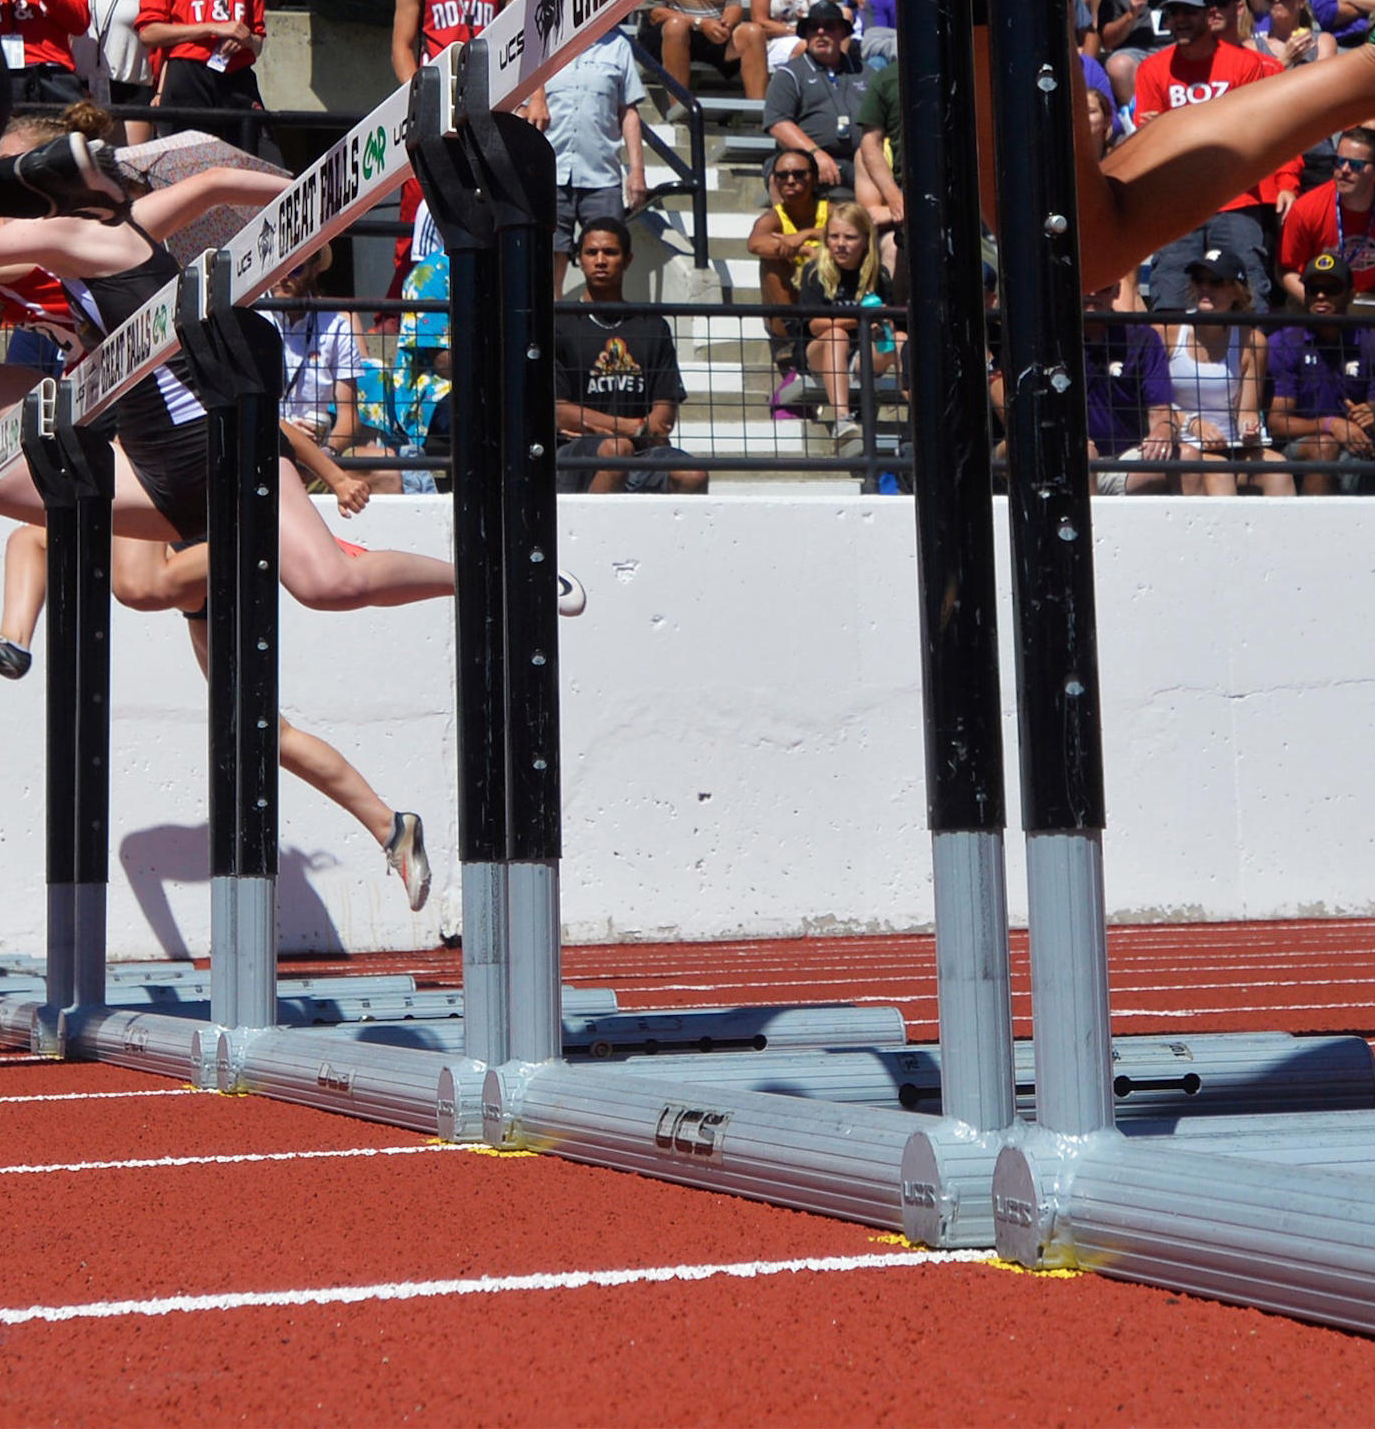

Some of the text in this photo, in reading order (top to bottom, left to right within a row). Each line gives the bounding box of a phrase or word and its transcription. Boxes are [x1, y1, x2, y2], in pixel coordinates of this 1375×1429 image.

[191, 0, 202, 22] T
[499, 29, 524, 71] UCS
[278, 172, 316, 260] GREAT
[320, 135, 360, 226] FALLS
